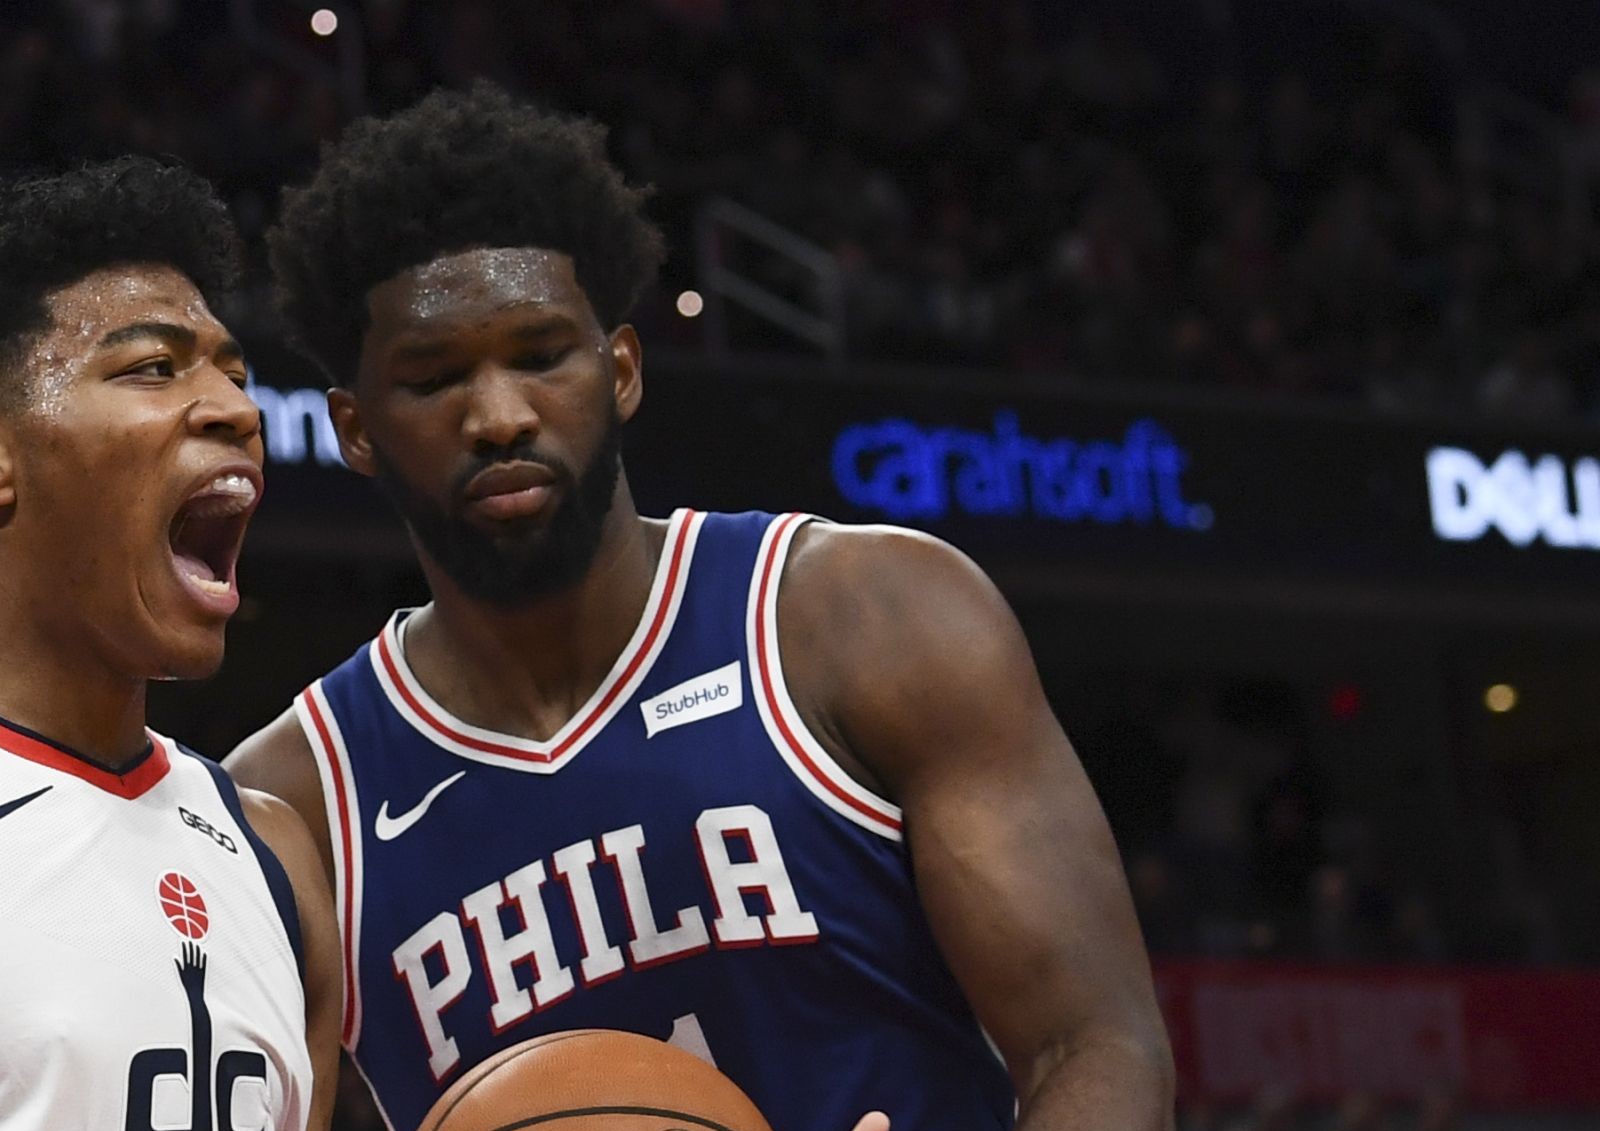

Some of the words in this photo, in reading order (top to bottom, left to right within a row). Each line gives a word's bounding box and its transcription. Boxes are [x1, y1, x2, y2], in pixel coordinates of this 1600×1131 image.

[655, 684, 730, 720] StubHub
[178, 806, 239, 855] GEICO
[392, 805, 820, 1086] PHILA
